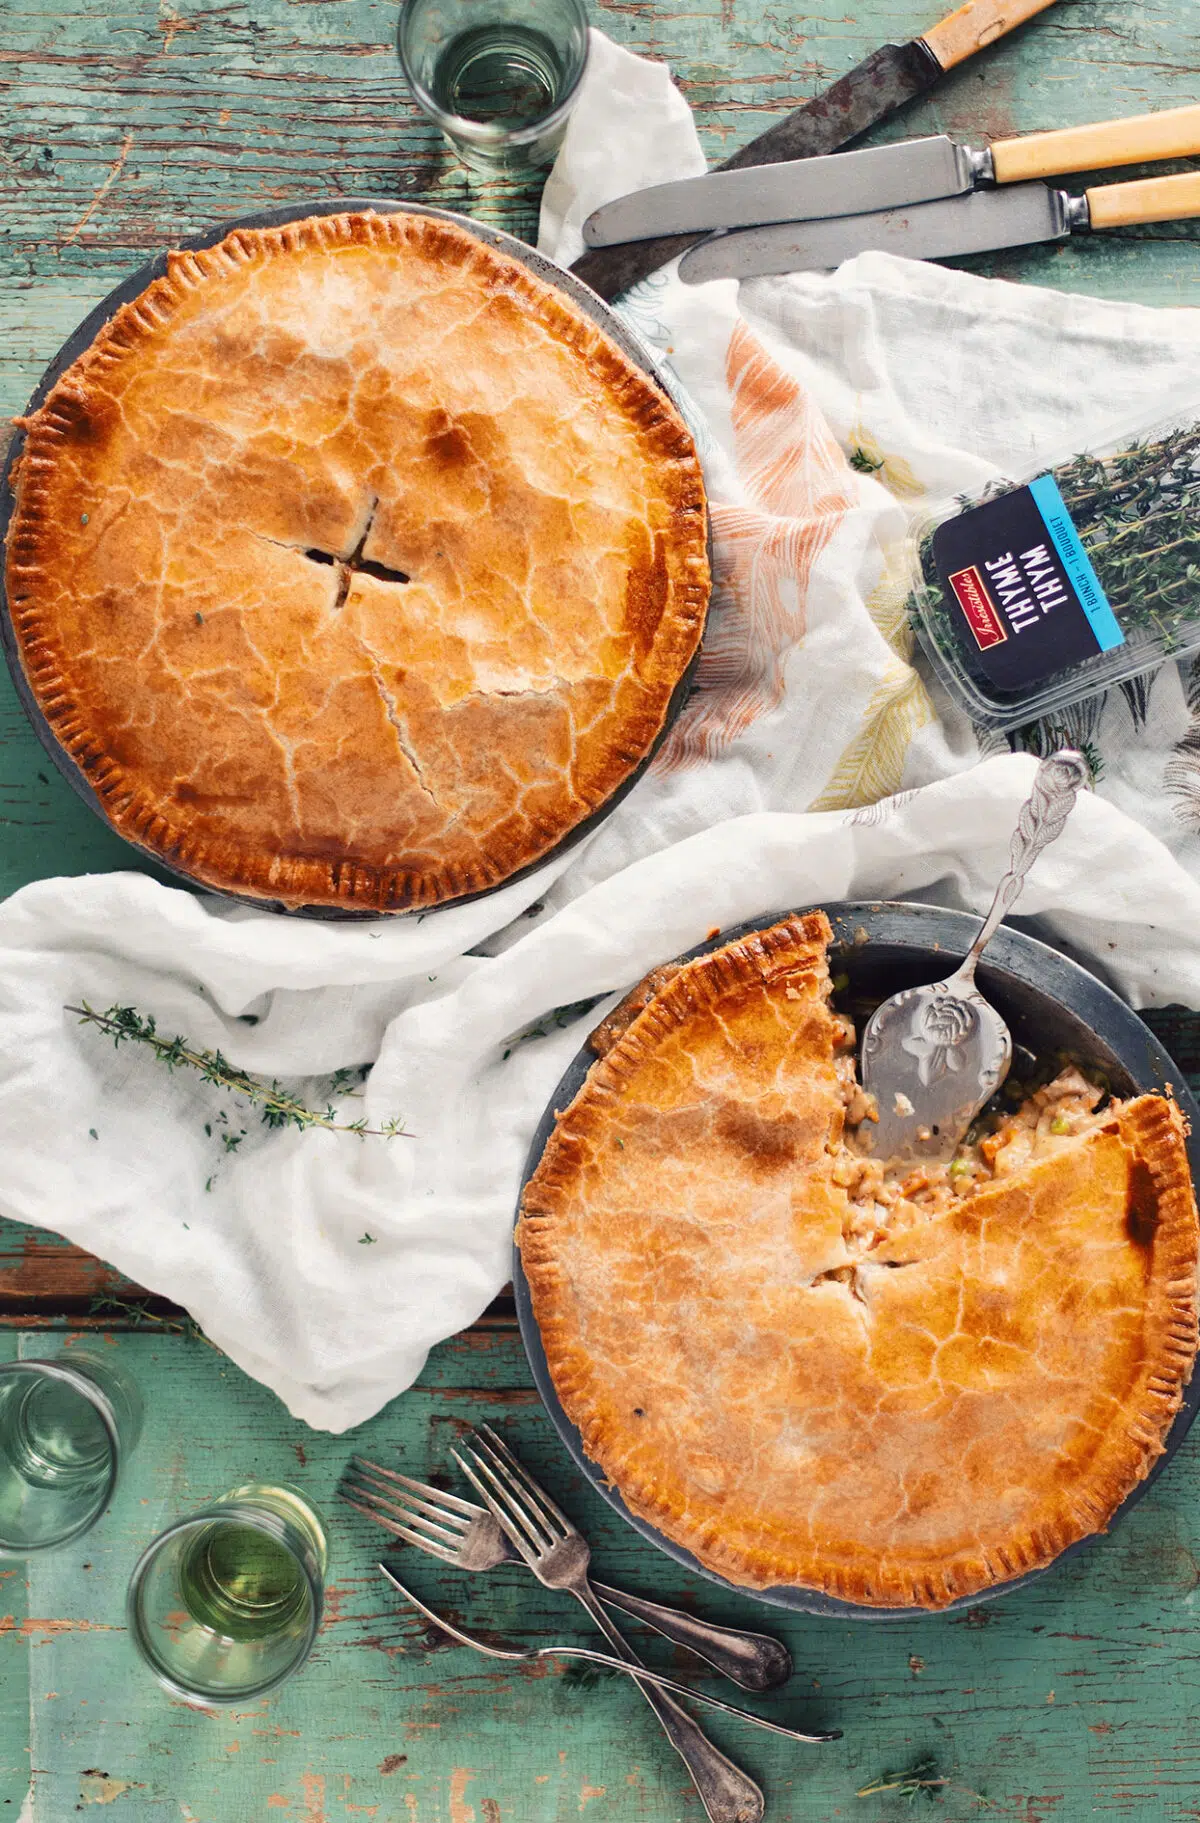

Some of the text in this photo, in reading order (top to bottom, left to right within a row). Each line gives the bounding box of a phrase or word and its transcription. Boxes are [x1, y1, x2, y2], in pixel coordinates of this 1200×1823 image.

[1049, 516, 1077, 558] BOUQUET
[959, 572, 999, 642] Irresistibles
[984, 551, 1040, 634] THYME
[1019, 543, 1068, 613] THYM
[1076, 573, 1098, 607] BUNCH
